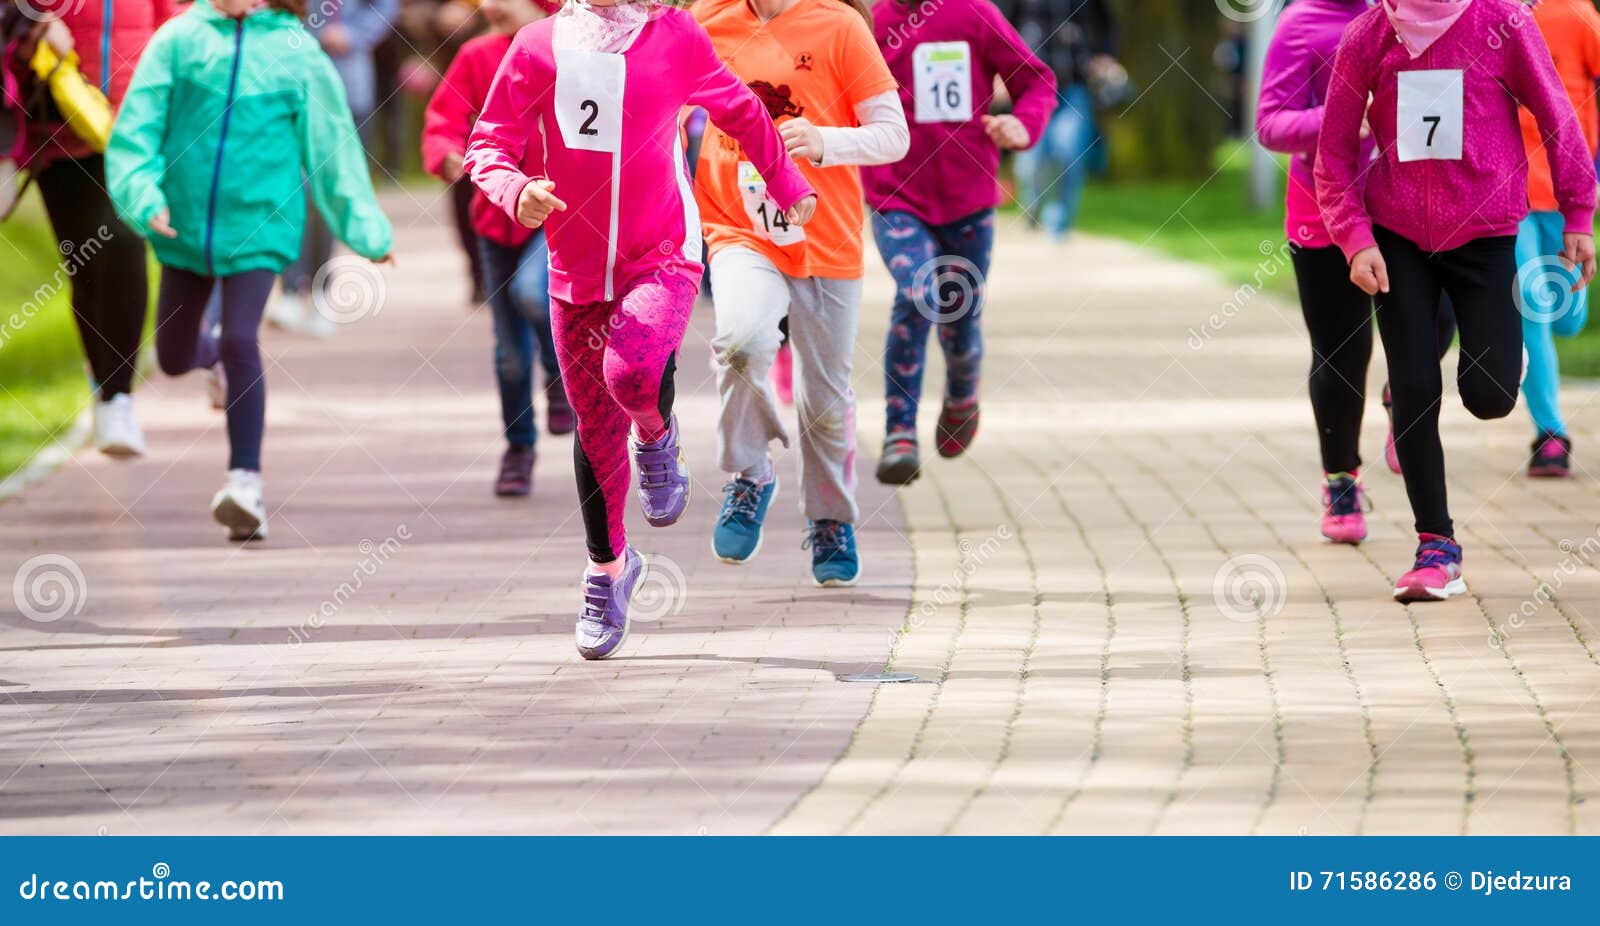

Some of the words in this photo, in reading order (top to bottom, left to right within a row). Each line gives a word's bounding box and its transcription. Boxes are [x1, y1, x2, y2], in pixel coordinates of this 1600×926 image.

[929, 80, 961, 109] 16
[578, 99, 599, 136] 2
[1422, 115, 1441, 147] 7
[757, 202, 790, 233] 14
